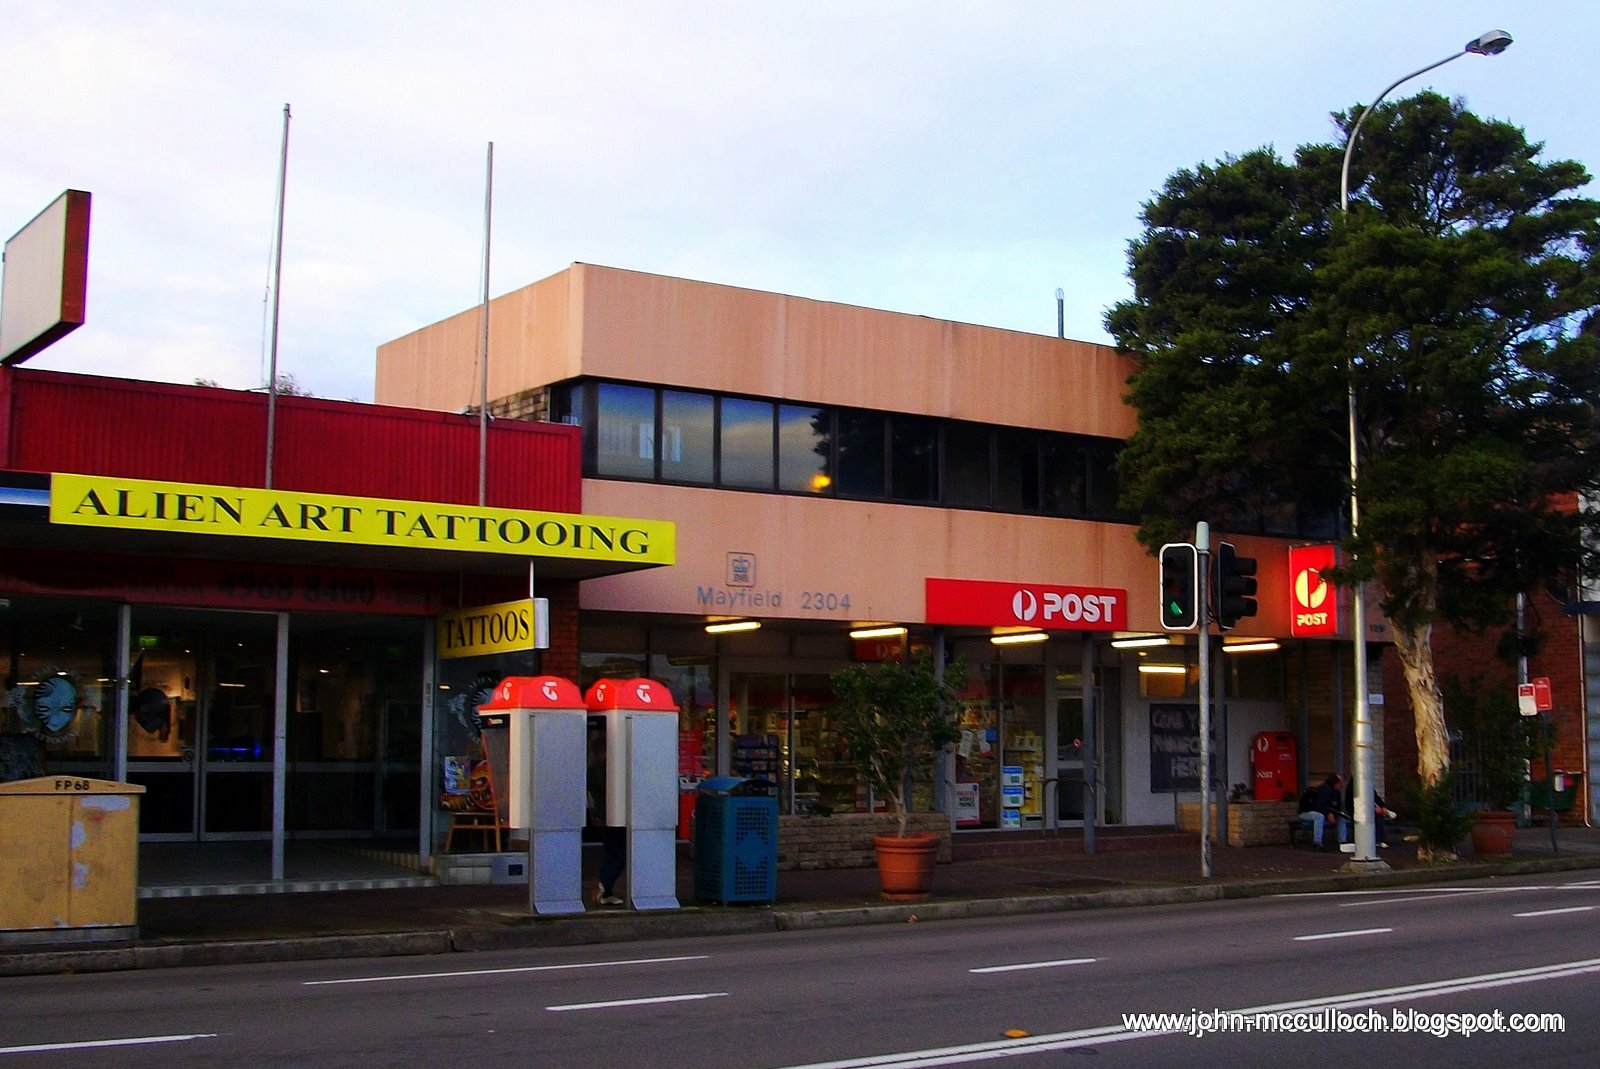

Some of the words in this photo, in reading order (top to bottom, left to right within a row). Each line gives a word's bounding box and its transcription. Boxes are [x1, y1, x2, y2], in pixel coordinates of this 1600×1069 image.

[72, 488, 245, 527] ALIEN
[259, 501, 362, 533] ART
[376, 508, 650, 554] TATTOOING
[696, 585, 782, 609] Mayfield
[801, 591, 851, 610] 2304
[1043, 592, 1117, 623] POST
[444, 608, 530, 649] TATTOOS
[1296, 612, 1329, 627] POST
[54, 779, 90, 791] FP68
